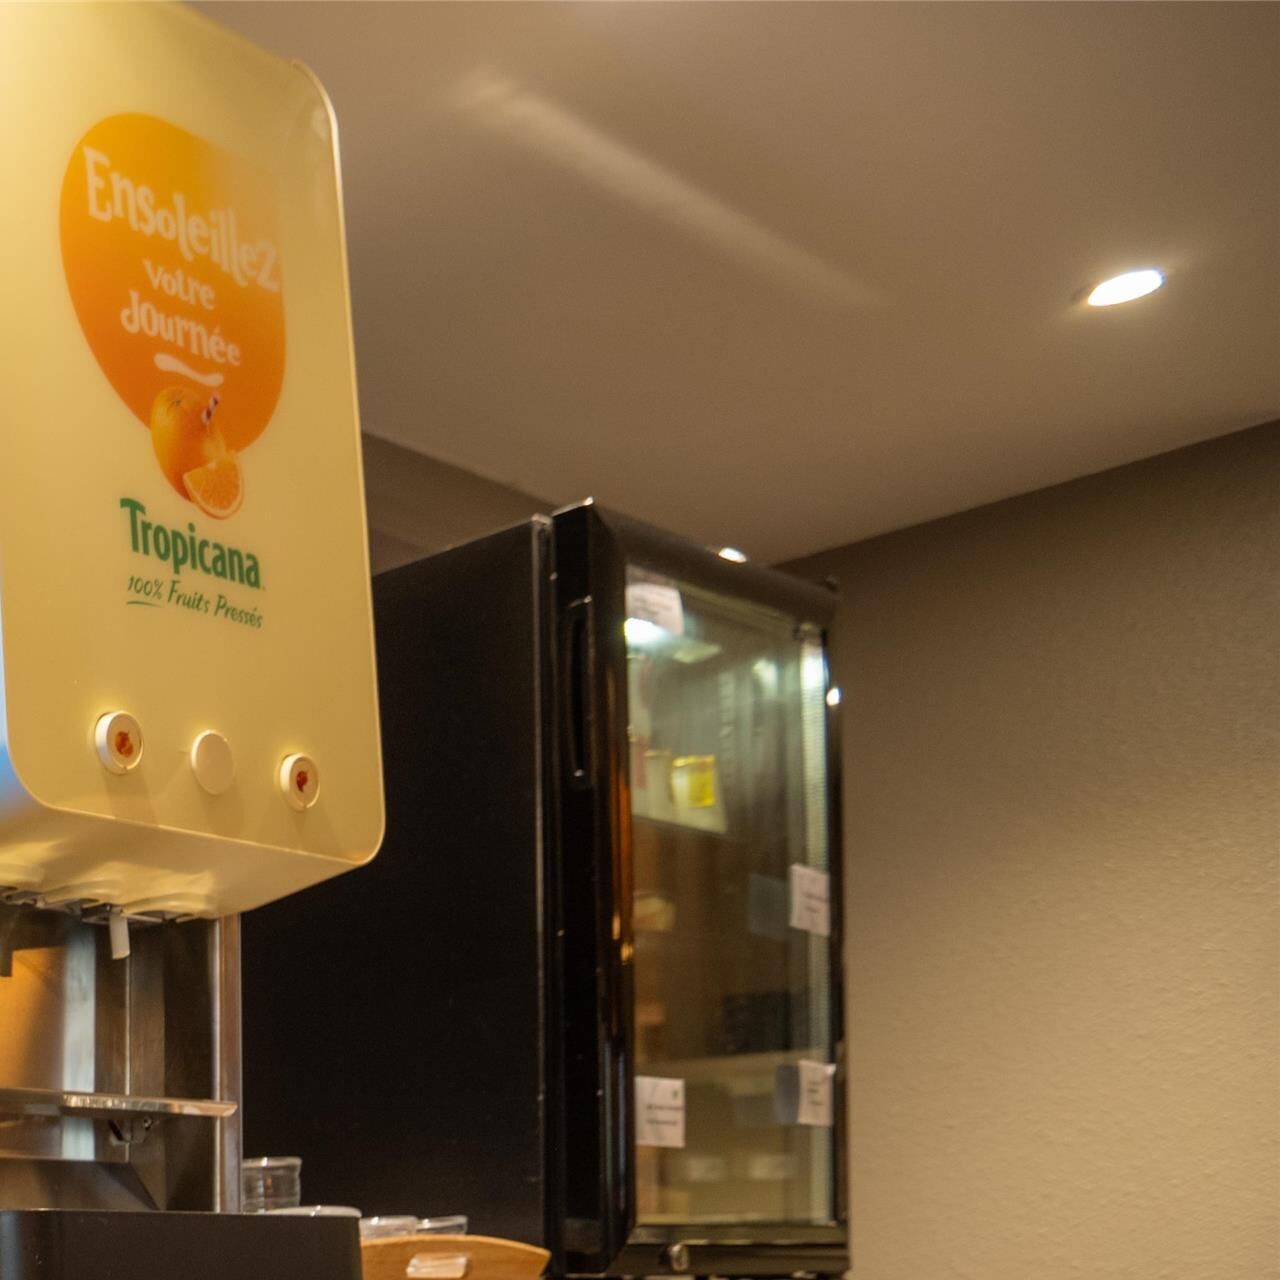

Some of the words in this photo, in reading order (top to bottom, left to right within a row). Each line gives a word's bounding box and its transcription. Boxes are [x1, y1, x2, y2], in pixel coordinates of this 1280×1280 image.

[120, 498, 261, 589] Tropicana
[128, 576, 164, 600] 100%
[168, 580, 211, 613] Fruits
[214, 594, 263, 628] Pressés
